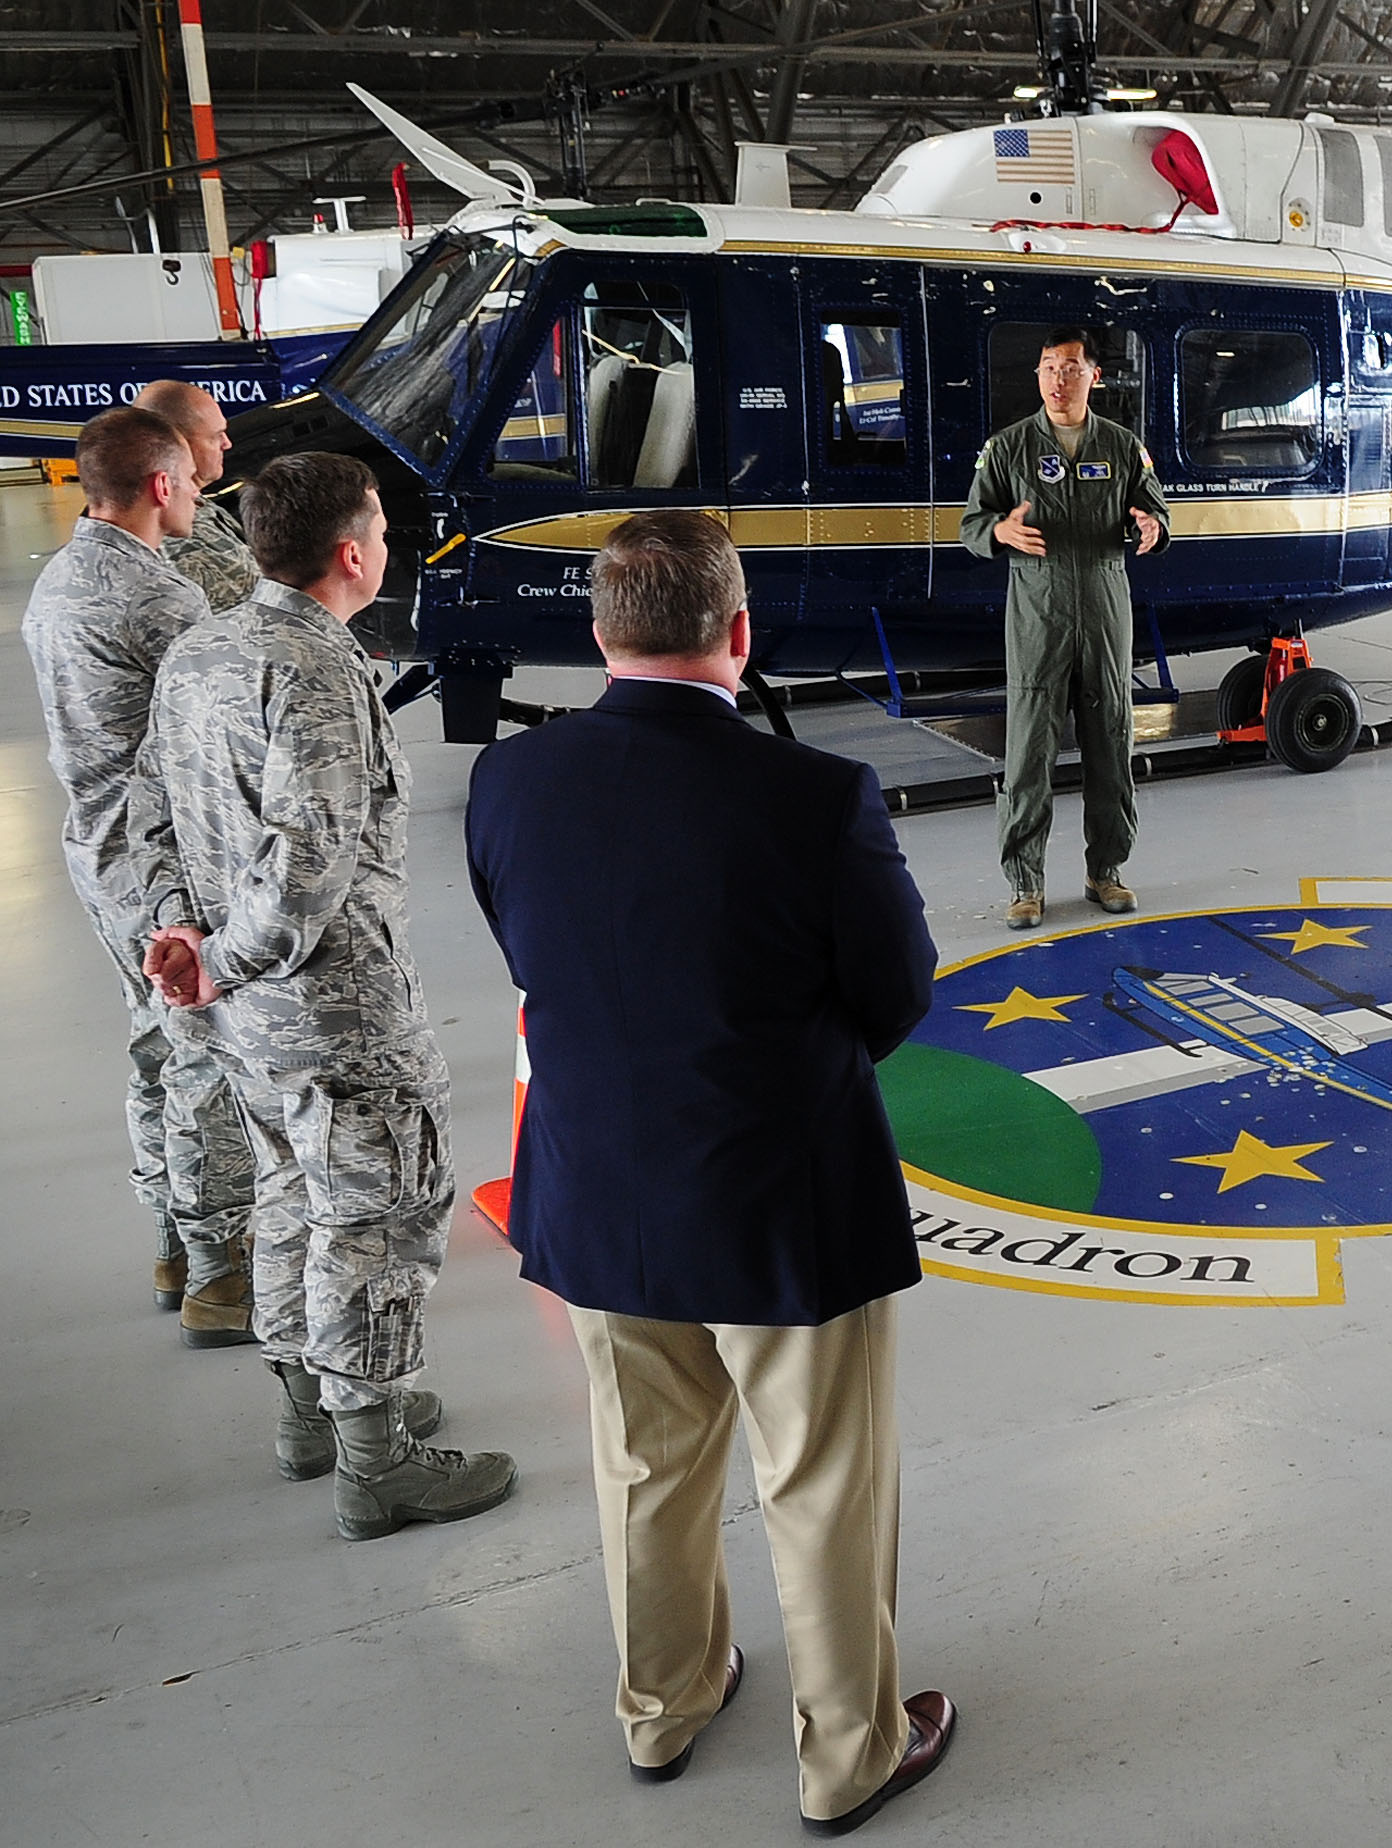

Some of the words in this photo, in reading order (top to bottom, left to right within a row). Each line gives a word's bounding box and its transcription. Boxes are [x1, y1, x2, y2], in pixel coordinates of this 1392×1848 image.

[27, 383, 113, 407] STATES
[1176, 483, 1204, 492] GLASS
[563, 566, 581, 580] FE
[517, 583, 557, 597] Crew
[560, 583, 593, 597] Chie
[909, 1207, 1255, 1283] uadron
